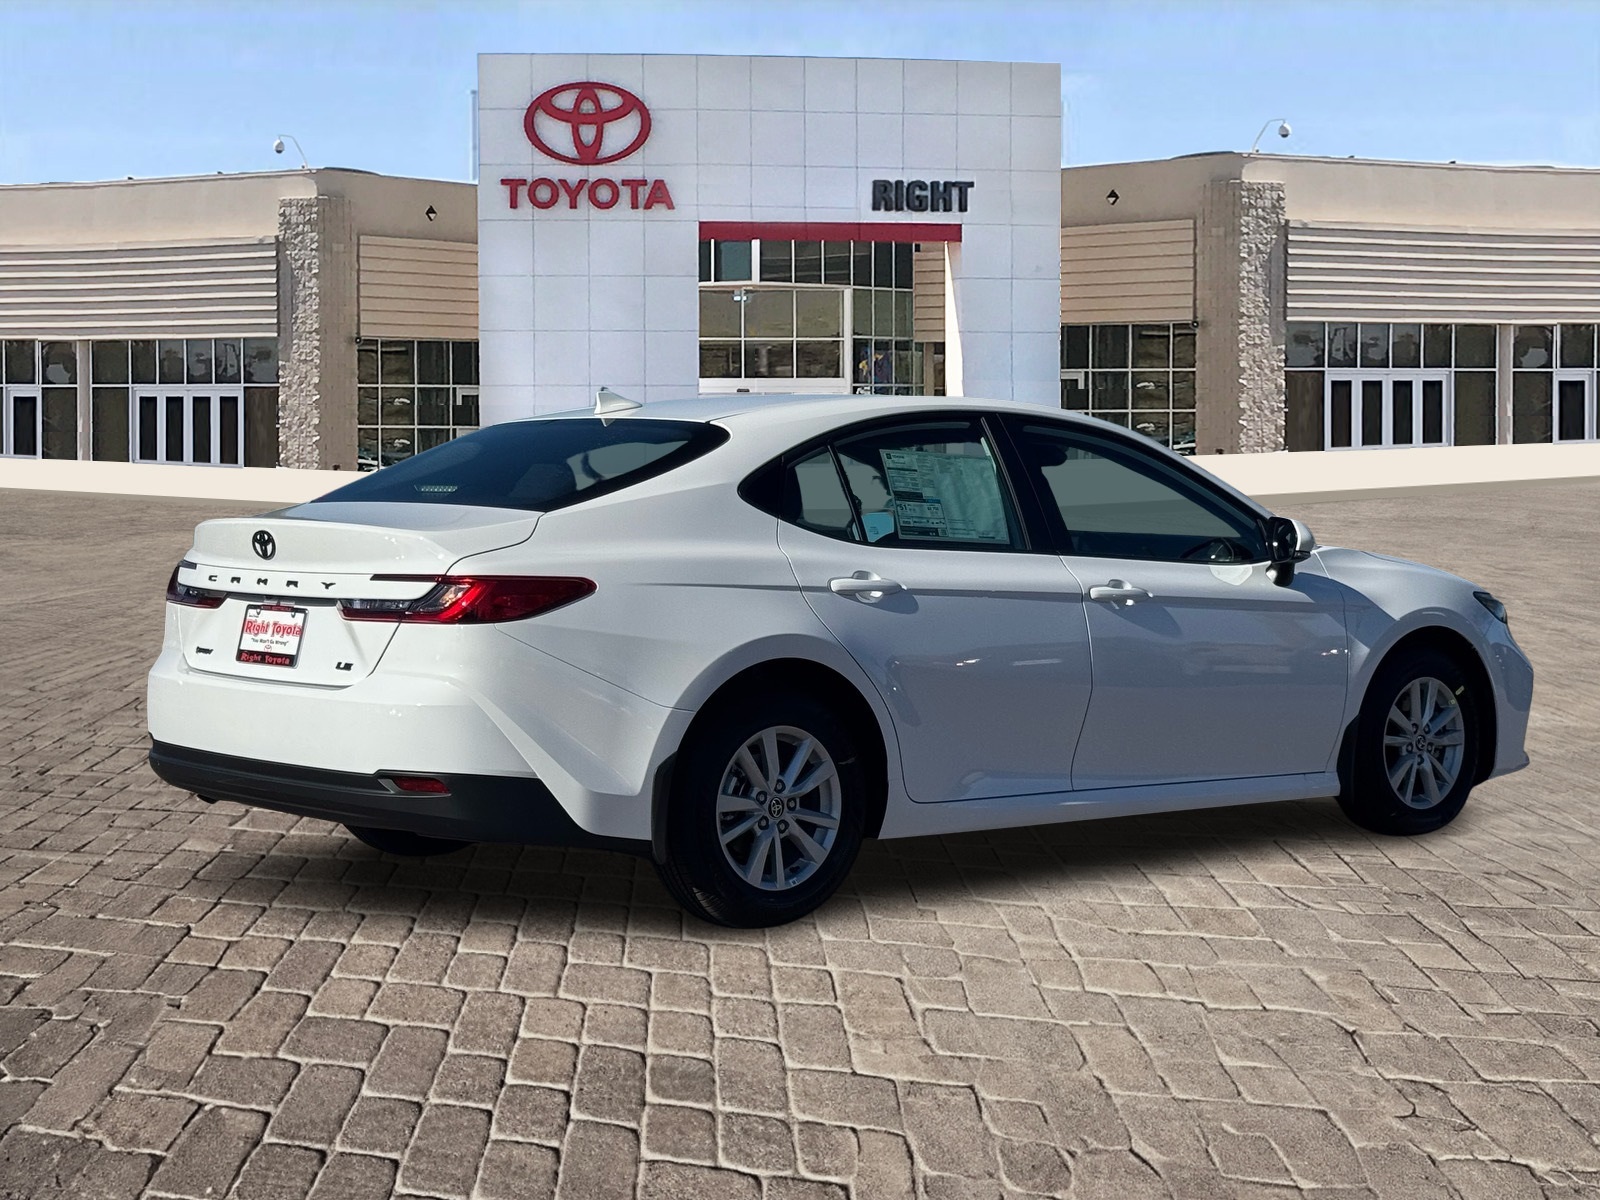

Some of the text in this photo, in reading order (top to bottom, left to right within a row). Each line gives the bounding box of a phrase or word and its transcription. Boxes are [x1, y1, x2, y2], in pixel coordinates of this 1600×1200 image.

[500, 178, 675, 210] TOYOTA
[871, 179, 975, 212] RIGHT
[208, 575, 336, 590] CAMRY
[244, 619, 303, 638] Right Toyota
[240, 652, 290, 665] Right Toyota
